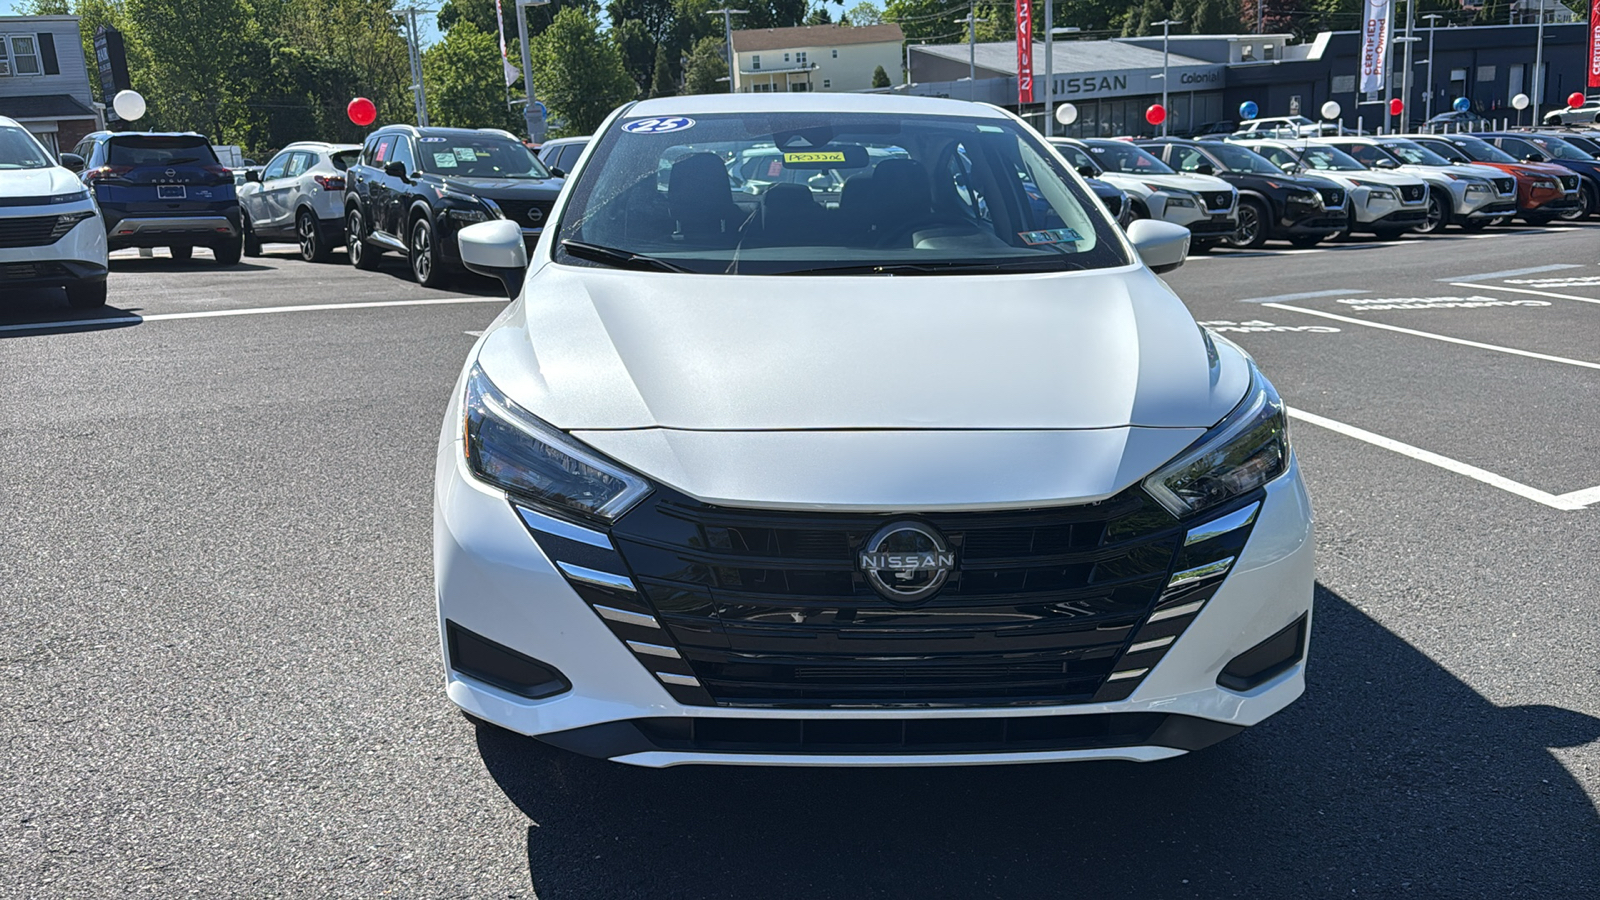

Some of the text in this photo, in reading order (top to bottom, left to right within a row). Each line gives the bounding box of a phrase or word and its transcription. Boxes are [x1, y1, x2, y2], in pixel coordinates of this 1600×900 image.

[1364, 19, 1377, 76] CERTIFIED
[1373, 18, 1386, 76] Pre-Owned
[1044, 75, 1127, 96] NISSAN
[1181, 70, 1219, 84] Colonial
[631, 118, 683, 133] 25
[862, 555, 953, 568] NISSAN
